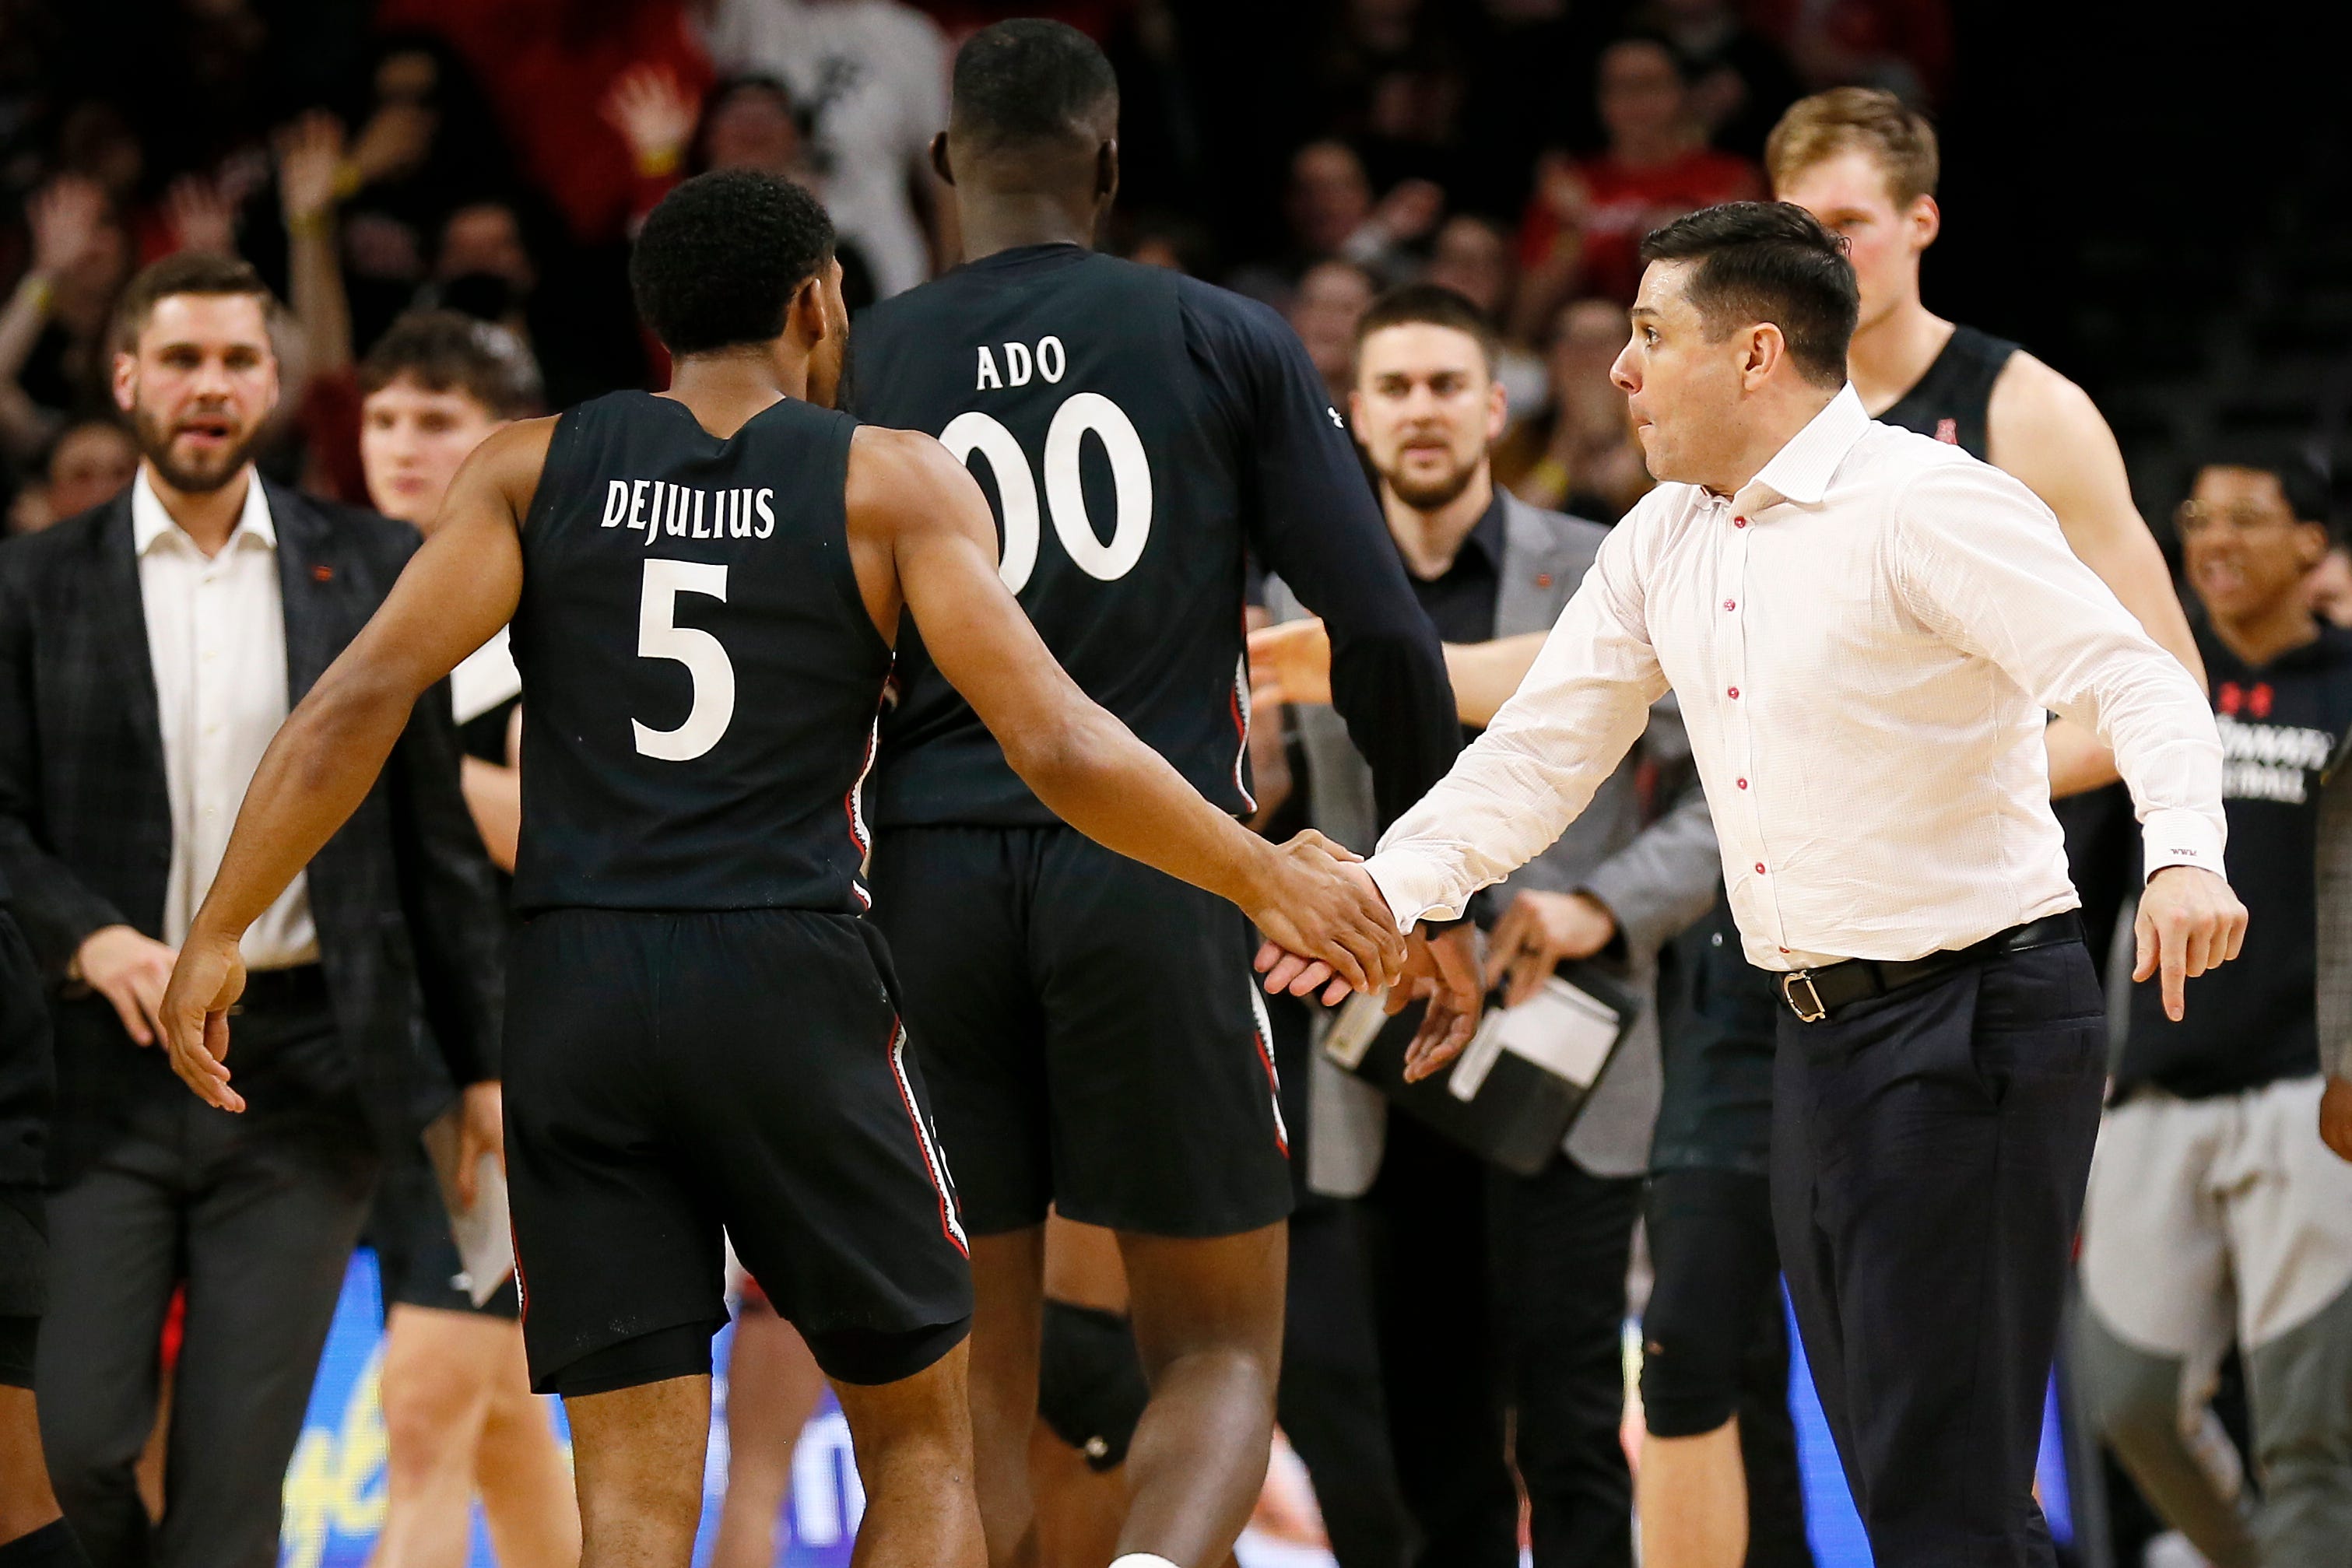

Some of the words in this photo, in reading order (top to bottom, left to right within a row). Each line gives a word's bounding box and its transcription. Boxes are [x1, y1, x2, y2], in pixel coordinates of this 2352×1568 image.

[976, 335, 1066, 391] ADO
[600, 479, 775, 546] DEJULIUS
[939, 392, 1153, 596] 00
[630, 558, 735, 762] 5
